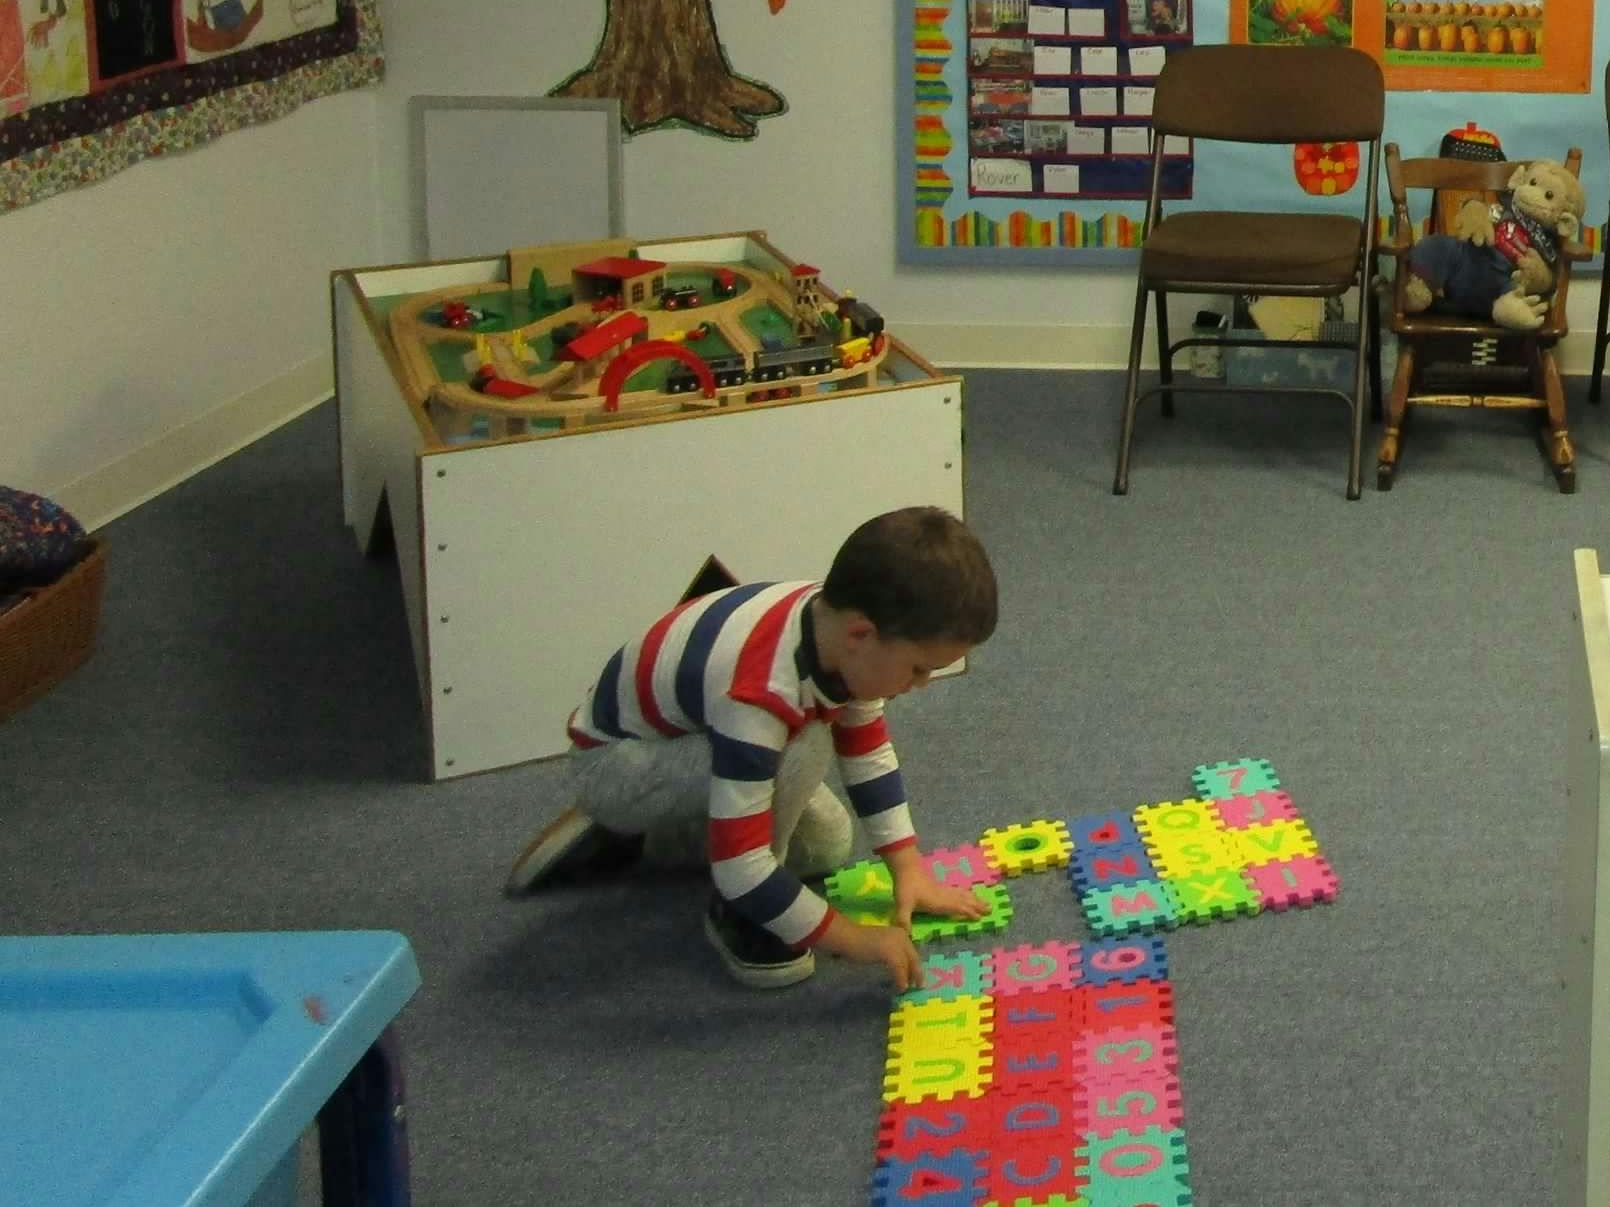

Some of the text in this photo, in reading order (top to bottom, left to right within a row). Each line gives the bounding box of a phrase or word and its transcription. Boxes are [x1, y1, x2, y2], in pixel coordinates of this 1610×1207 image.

[1216, 767, 1249, 790] 7
[1249, 829, 1285, 852] V
[1180, 844, 1212, 865] S
[932, 856, 972, 882] H
[1188, 877, 1235, 904] X
[928, 967, 965, 990] K
[1007, 953, 1058, 981] G
[1007, 1008, 1057, 1023] F
[1096, 995, 1147, 1012] 1
[915, 1010, 968, 1028] T
[1007, 1053, 1059, 1073] E
[1094, 1039, 1153, 1064] 3
[912, 1058, 966, 1085] U
[1004, 1101, 1061, 1131] D
[1096, 1091, 1157, 1118] 5
[904, 1112, 966, 1139] 2
[1002, 1154, 1062, 1186] C
